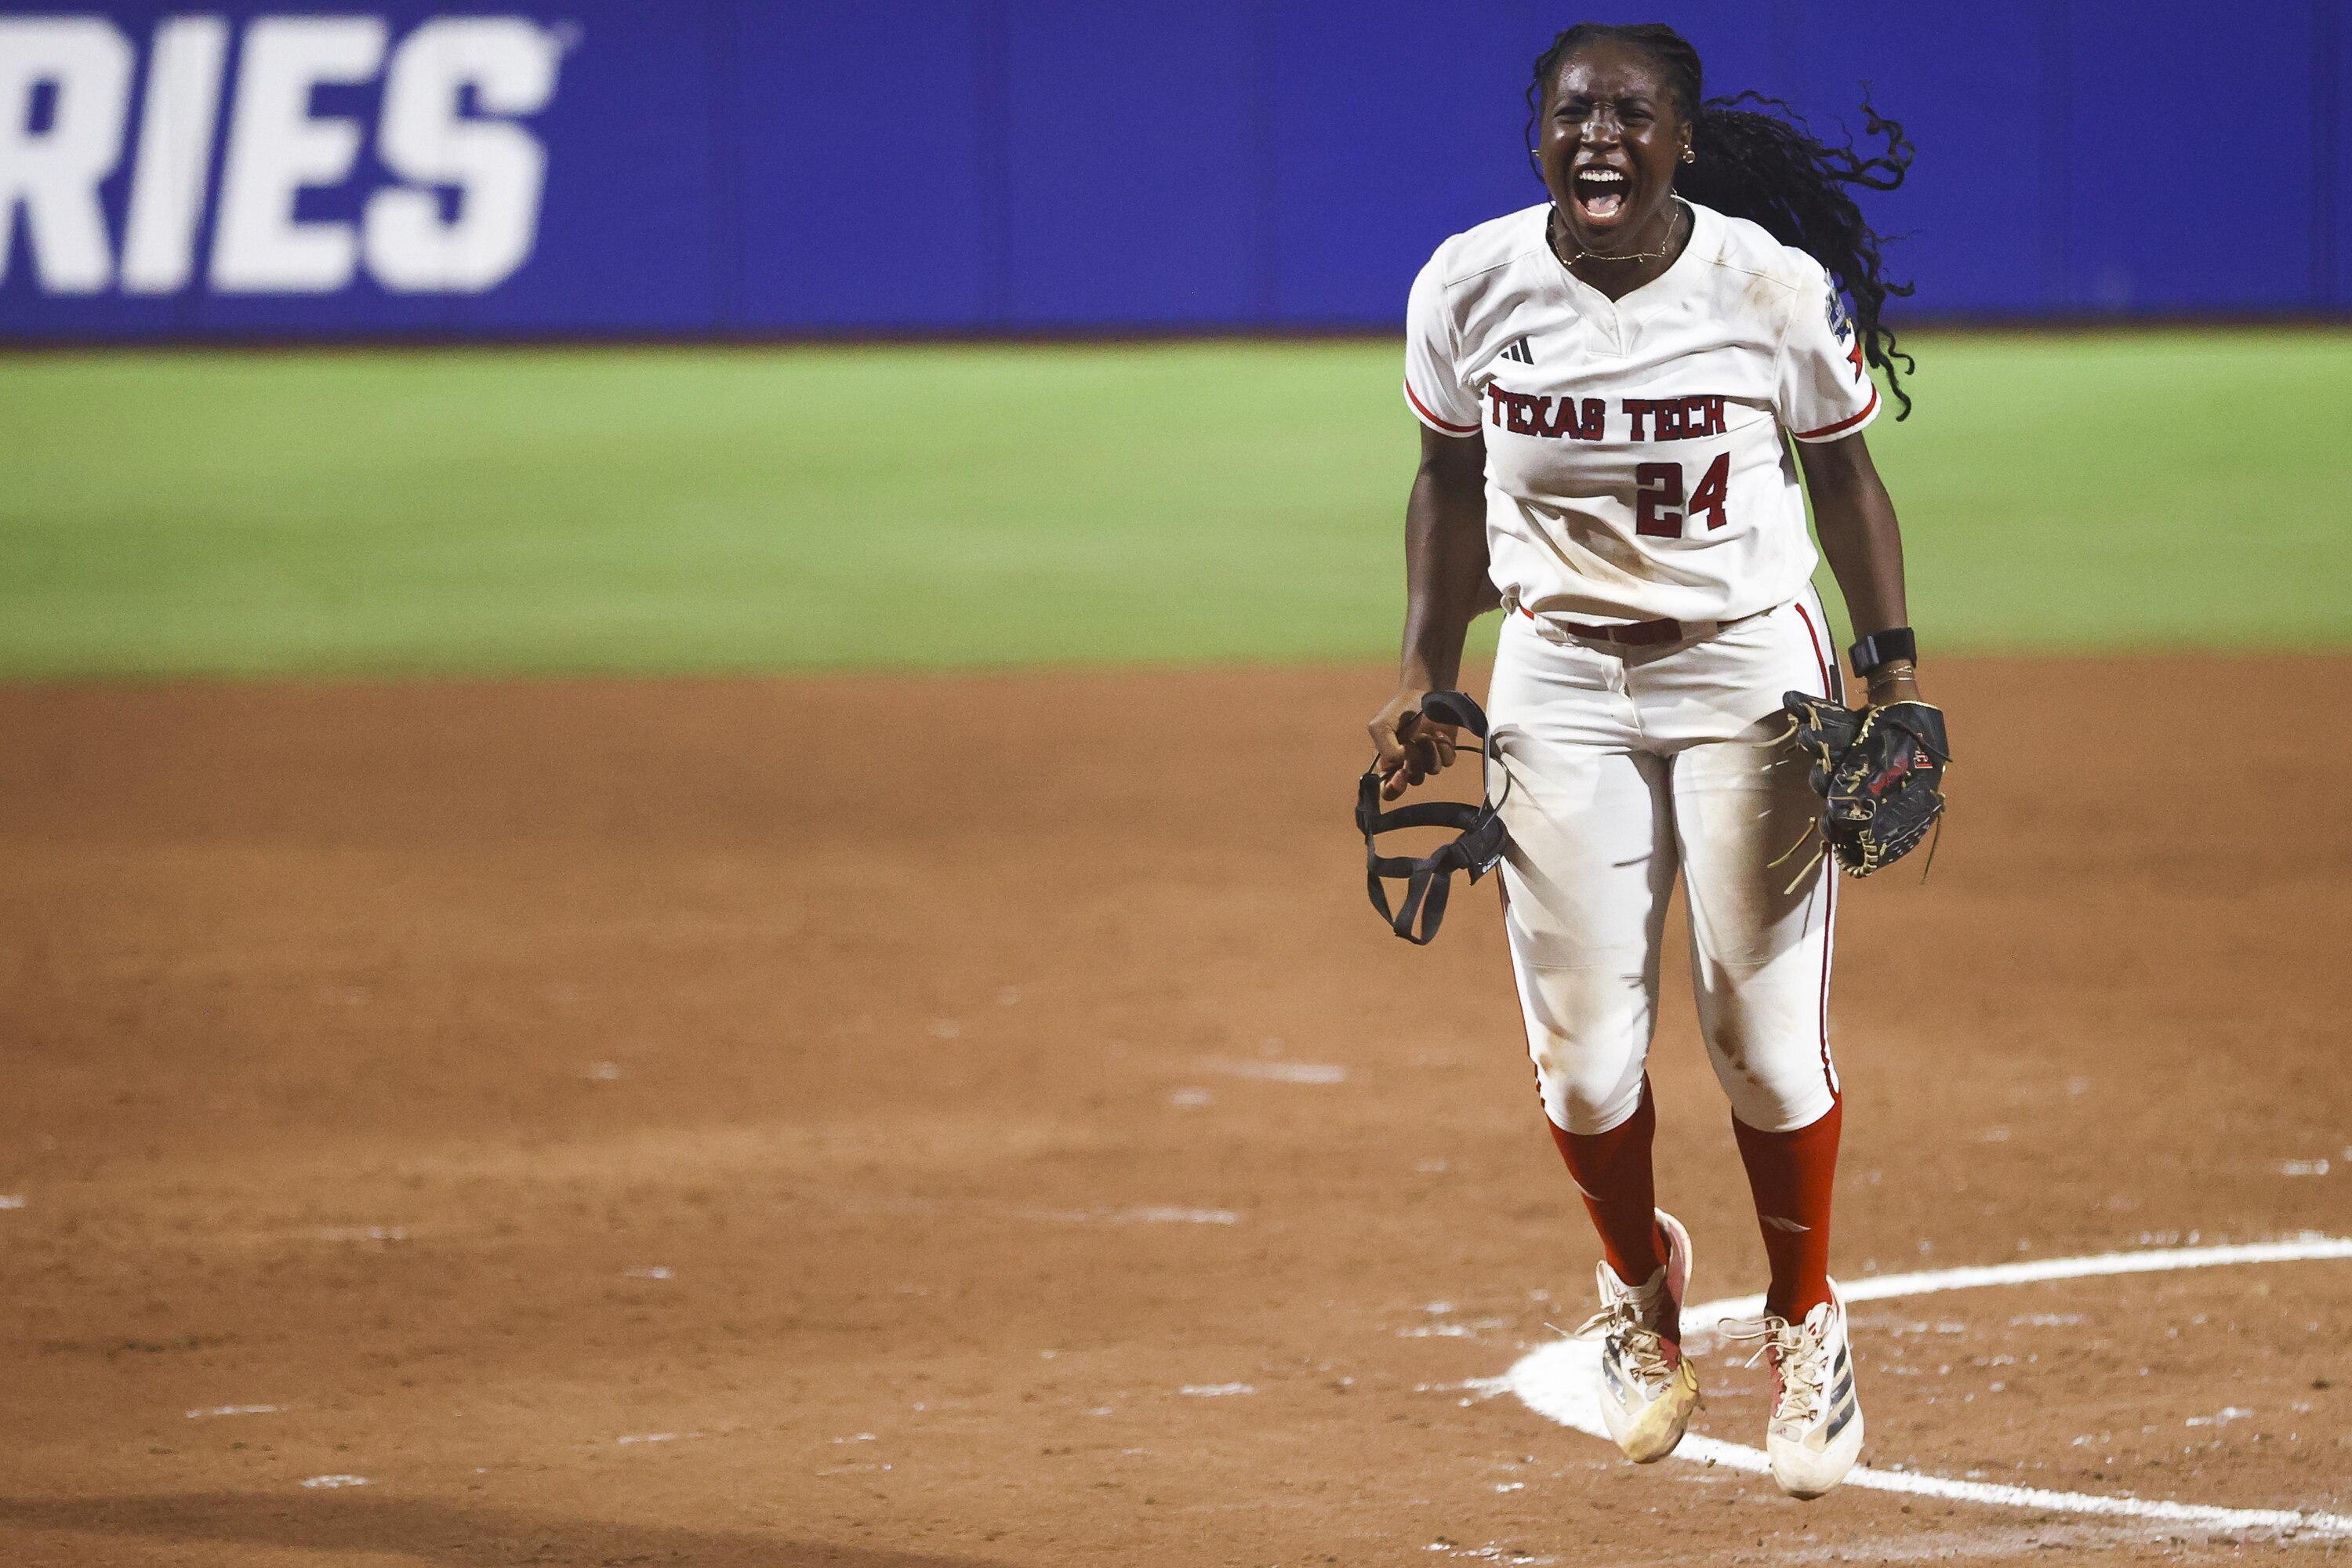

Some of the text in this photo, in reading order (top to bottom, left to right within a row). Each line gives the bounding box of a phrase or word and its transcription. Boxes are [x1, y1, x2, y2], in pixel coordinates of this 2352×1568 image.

[0, 16, 558, 293] RIES
[1488, 381, 1727, 442] TEXAS TECH
[1635, 451, 1730, 539] 24
